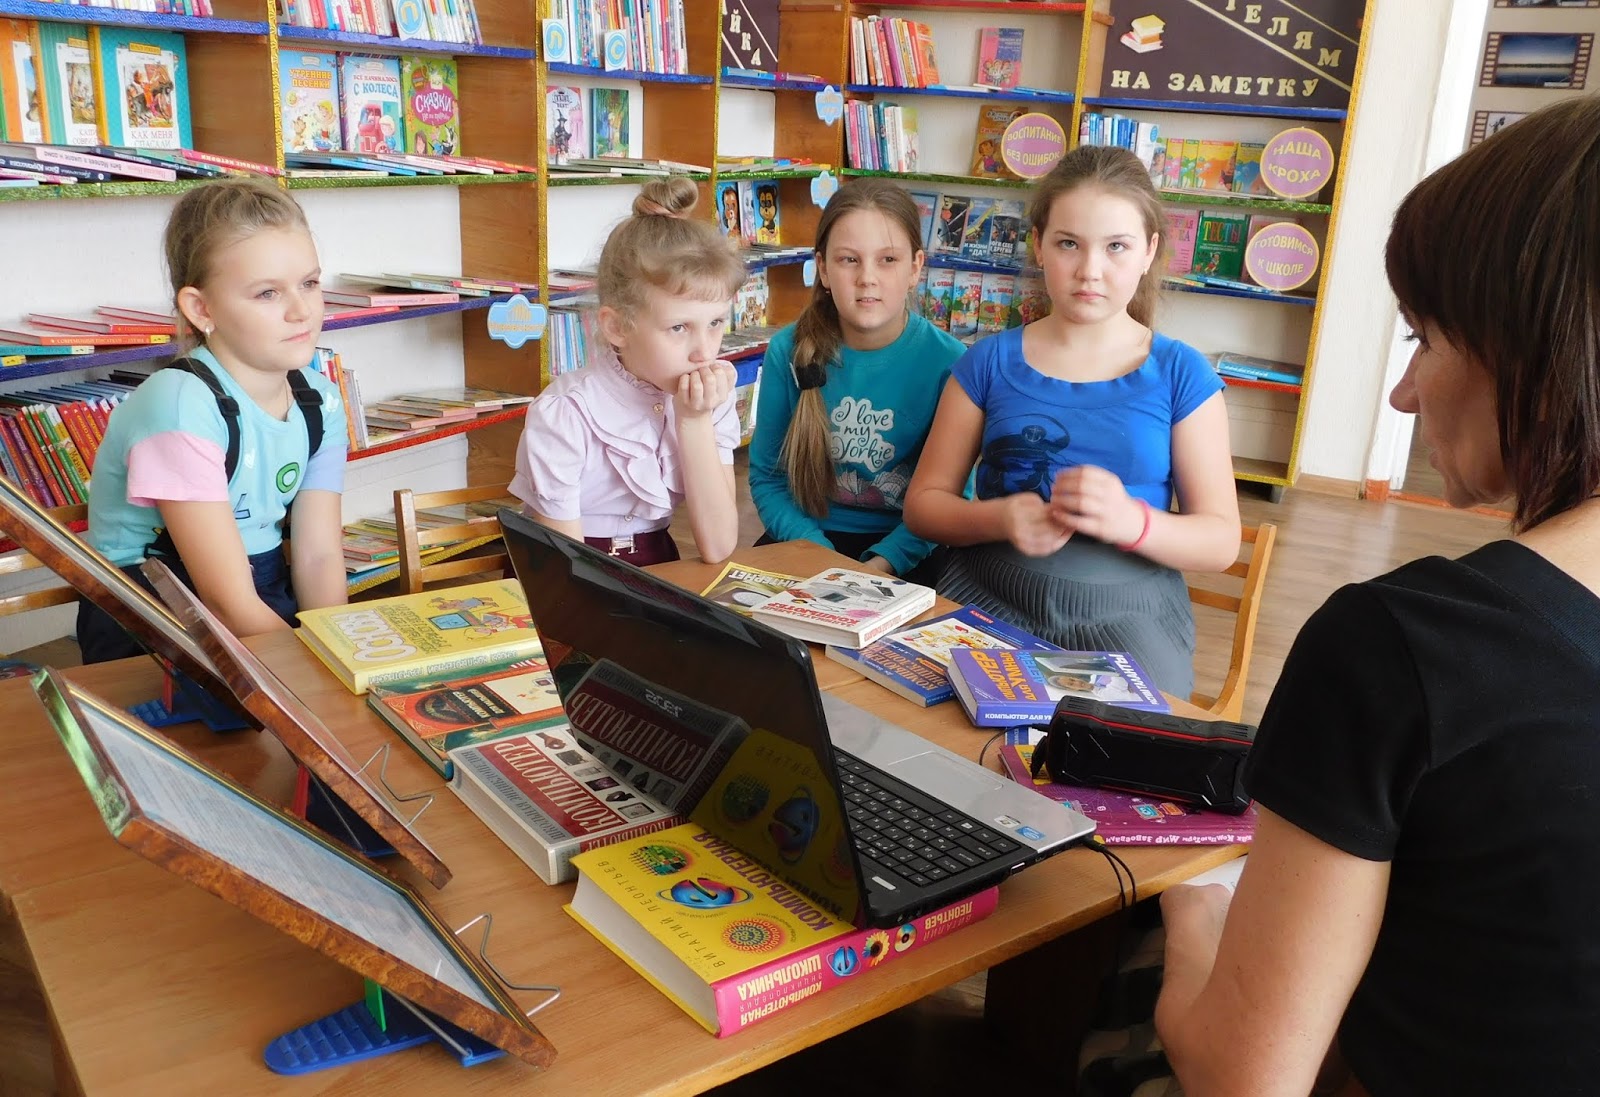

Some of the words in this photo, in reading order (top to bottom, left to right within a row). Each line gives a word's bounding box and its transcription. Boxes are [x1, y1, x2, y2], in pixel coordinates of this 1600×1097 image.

[289, 68, 332, 80] УТРЕННИЕ
[292, 78, 331, 89] ПЕСЕНКИ
[1110, 69, 1151, 89] НА
[1168, 72, 1319, 97] ЗАМЕТКУ
[353, 84, 360, 96] С
[362, 83, 398, 98] КОЛЕСА
[415, 91, 452, 113] СКАЗКИ
[131, 131, 149, 139] КАК
[151, 131, 173, 139] МЕНЯ
[1007, 126, 1061, 143] ВОСПИТАНИЕ
[1006, 149, 1020, 162] БЕЗ
[1022, 151, 1060, 166] ОШИБОК
[1273, 143, 1322, 160] НАША
[1268, 164, 1321, 184] КРОХА
[1203, 221, 1242, 244] ТЕСТЫ
[1254, 234, 1313, 257] ГОТОВИМСЯ
[1257, 258, 1265, 270] К
[1266, 260, 1304, 277] ШКОЛЕ
[835, 401, 851, 422] I
[856, 404, 889, 426] love
[844, 425, 870, 446] my
[831, 436, 892, 469] Yorkie
[728, 570, 802, 588] ИНТЕРНЕТ
[768, 602, 860, 625] КОМПЬЮТЕР
[329, 608, 418, 663] ОСНОВЫ
[368, 666, 425, 685] ГРАМОТНОСТИ
[427, 655, 489, 675] КОМПЬЮТЕРНОЙ
[861, 647, 938, 691] КОМПЬЮТЕРН
[867, 642, 946, 687] ЭНЦИКЛОПЕДИ
[970, 651, 1017, 700] КОМПЬЮТЕР
[458, 750, 526, 803] ЭНЦИКЛОПЕДИЯ
[494, 743, 623, 831] КОМПЬЮТЕР
[514, 801, 566, 840] ШКОЛЬНАЯ
[597, 861, 661, 912] ЛЕОНТЬЕВ
[692, 833, 834, 931] КОМПЬЮТЕРНАЯ
[922, 913, 972, 942] ВИТАЛИЙ
[924, 901, 973, 930] ЛЕОНТЬЕВ
[659, 913, 726, 968] ВИТАЛИЙ
[737, 954, 822, 1001] ШКОЛЬНИКА
[740, 980, 823, 1027] КОМПЬЮТЕРНАЯ
